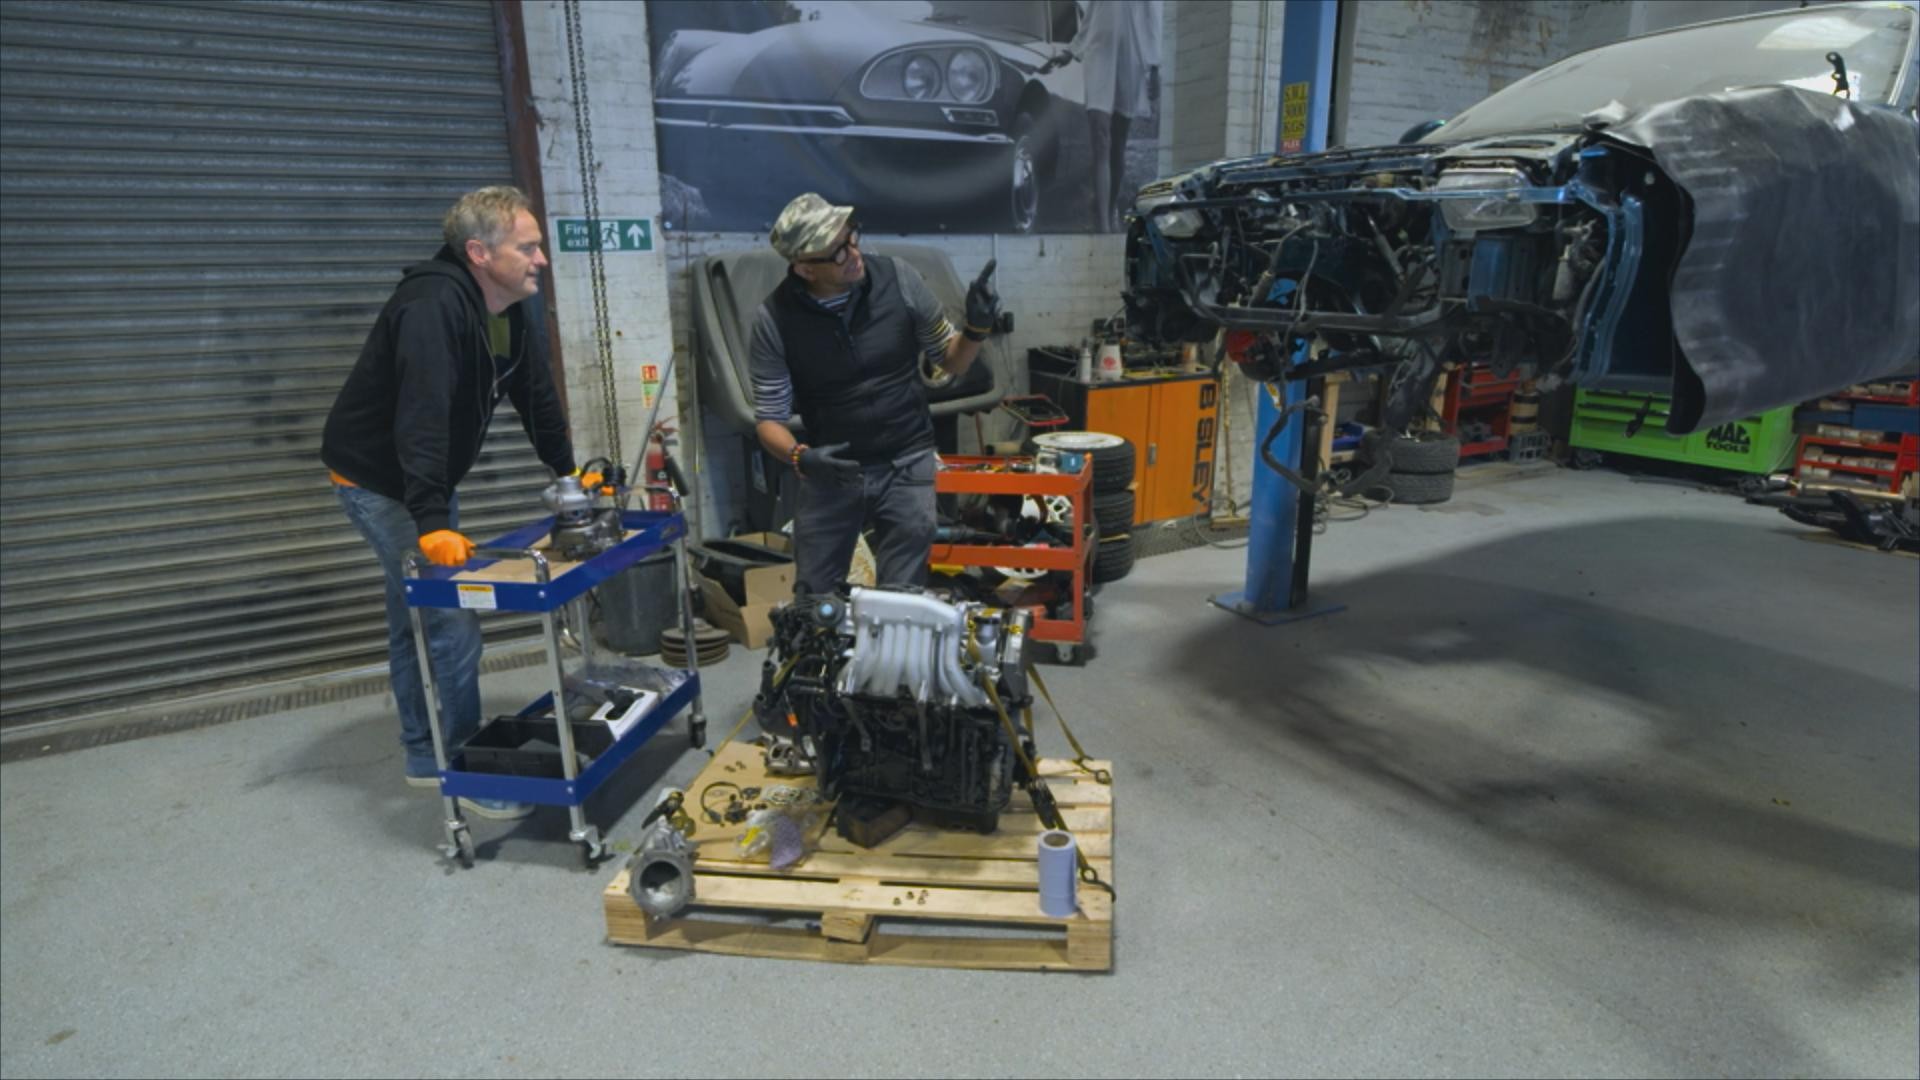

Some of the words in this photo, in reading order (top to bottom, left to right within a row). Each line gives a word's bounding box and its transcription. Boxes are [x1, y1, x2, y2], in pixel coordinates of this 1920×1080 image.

[564, 223, 589, 235] Fire
[566, 236, 590, 248] exit
[1706, 422, 1750, 445] MAC
[1706, 440, 1750, 455] TOOLS
